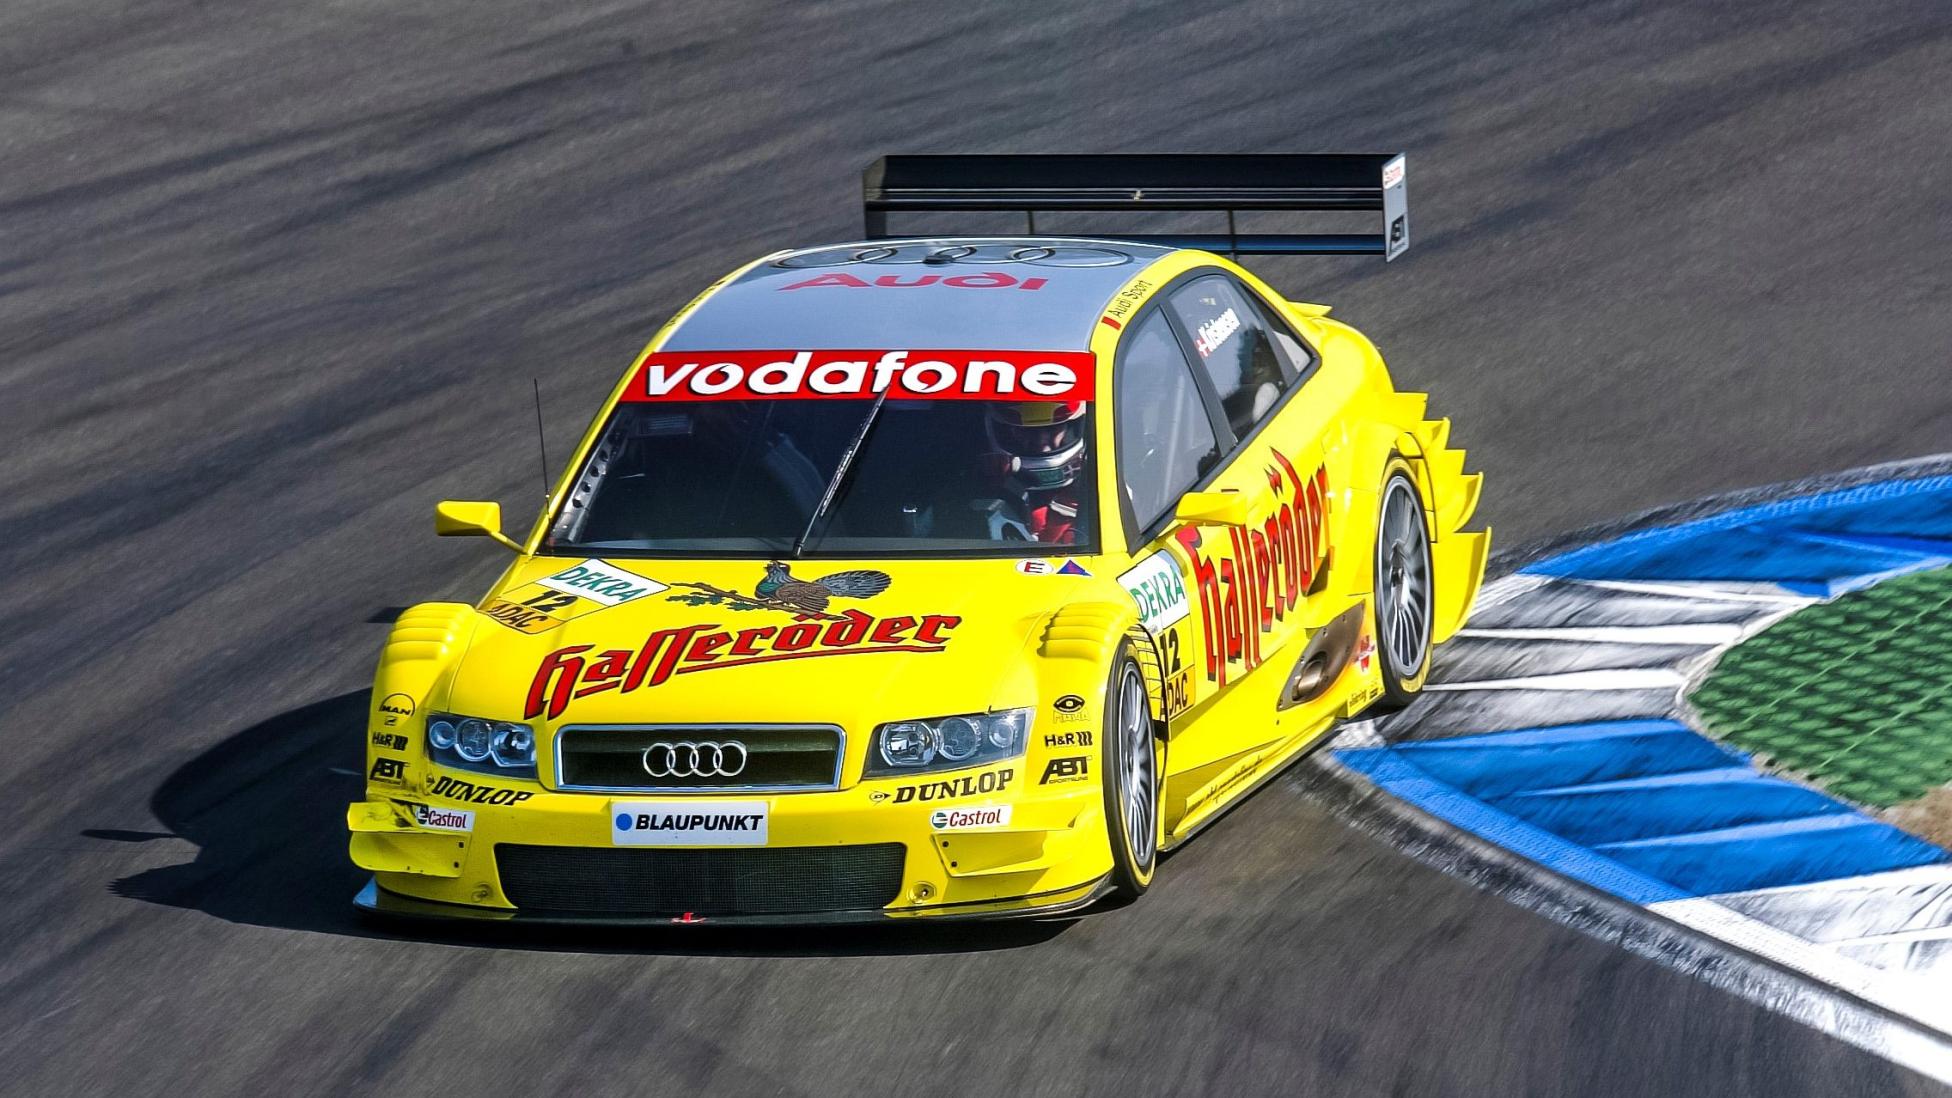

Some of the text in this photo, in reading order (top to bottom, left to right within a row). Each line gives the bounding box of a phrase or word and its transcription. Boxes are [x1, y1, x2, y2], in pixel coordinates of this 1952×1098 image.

[776, 271, 1050, 291] Audi
[1108, 280, 1153, 319] Audi Sport
[647, 351, 1079, 396] vodafone
[551, 566, 649, 602] DEKRA
[1129, 565, 1186, 624] DEKRA
[520, 589, 579, 613] 12
[486, 603, 549, 628] ADAC
[1159, 627, 1181, 678] 12
[380, 705, 412, 716] MAN
[1044, 732, 1075, 747] H&R
[370, 757, 407, 780] ABT
[1039, 756, 1088, 785] ABT
[431, 776, 536, 806] DUNLOP
[892, 768, 1014, 804] DUNLOP
[428, 810, 467, 829] Castrol
[635, 813, 764, 832] BLAUPUNKT
[949, 808, 1001, 827] Castrol
